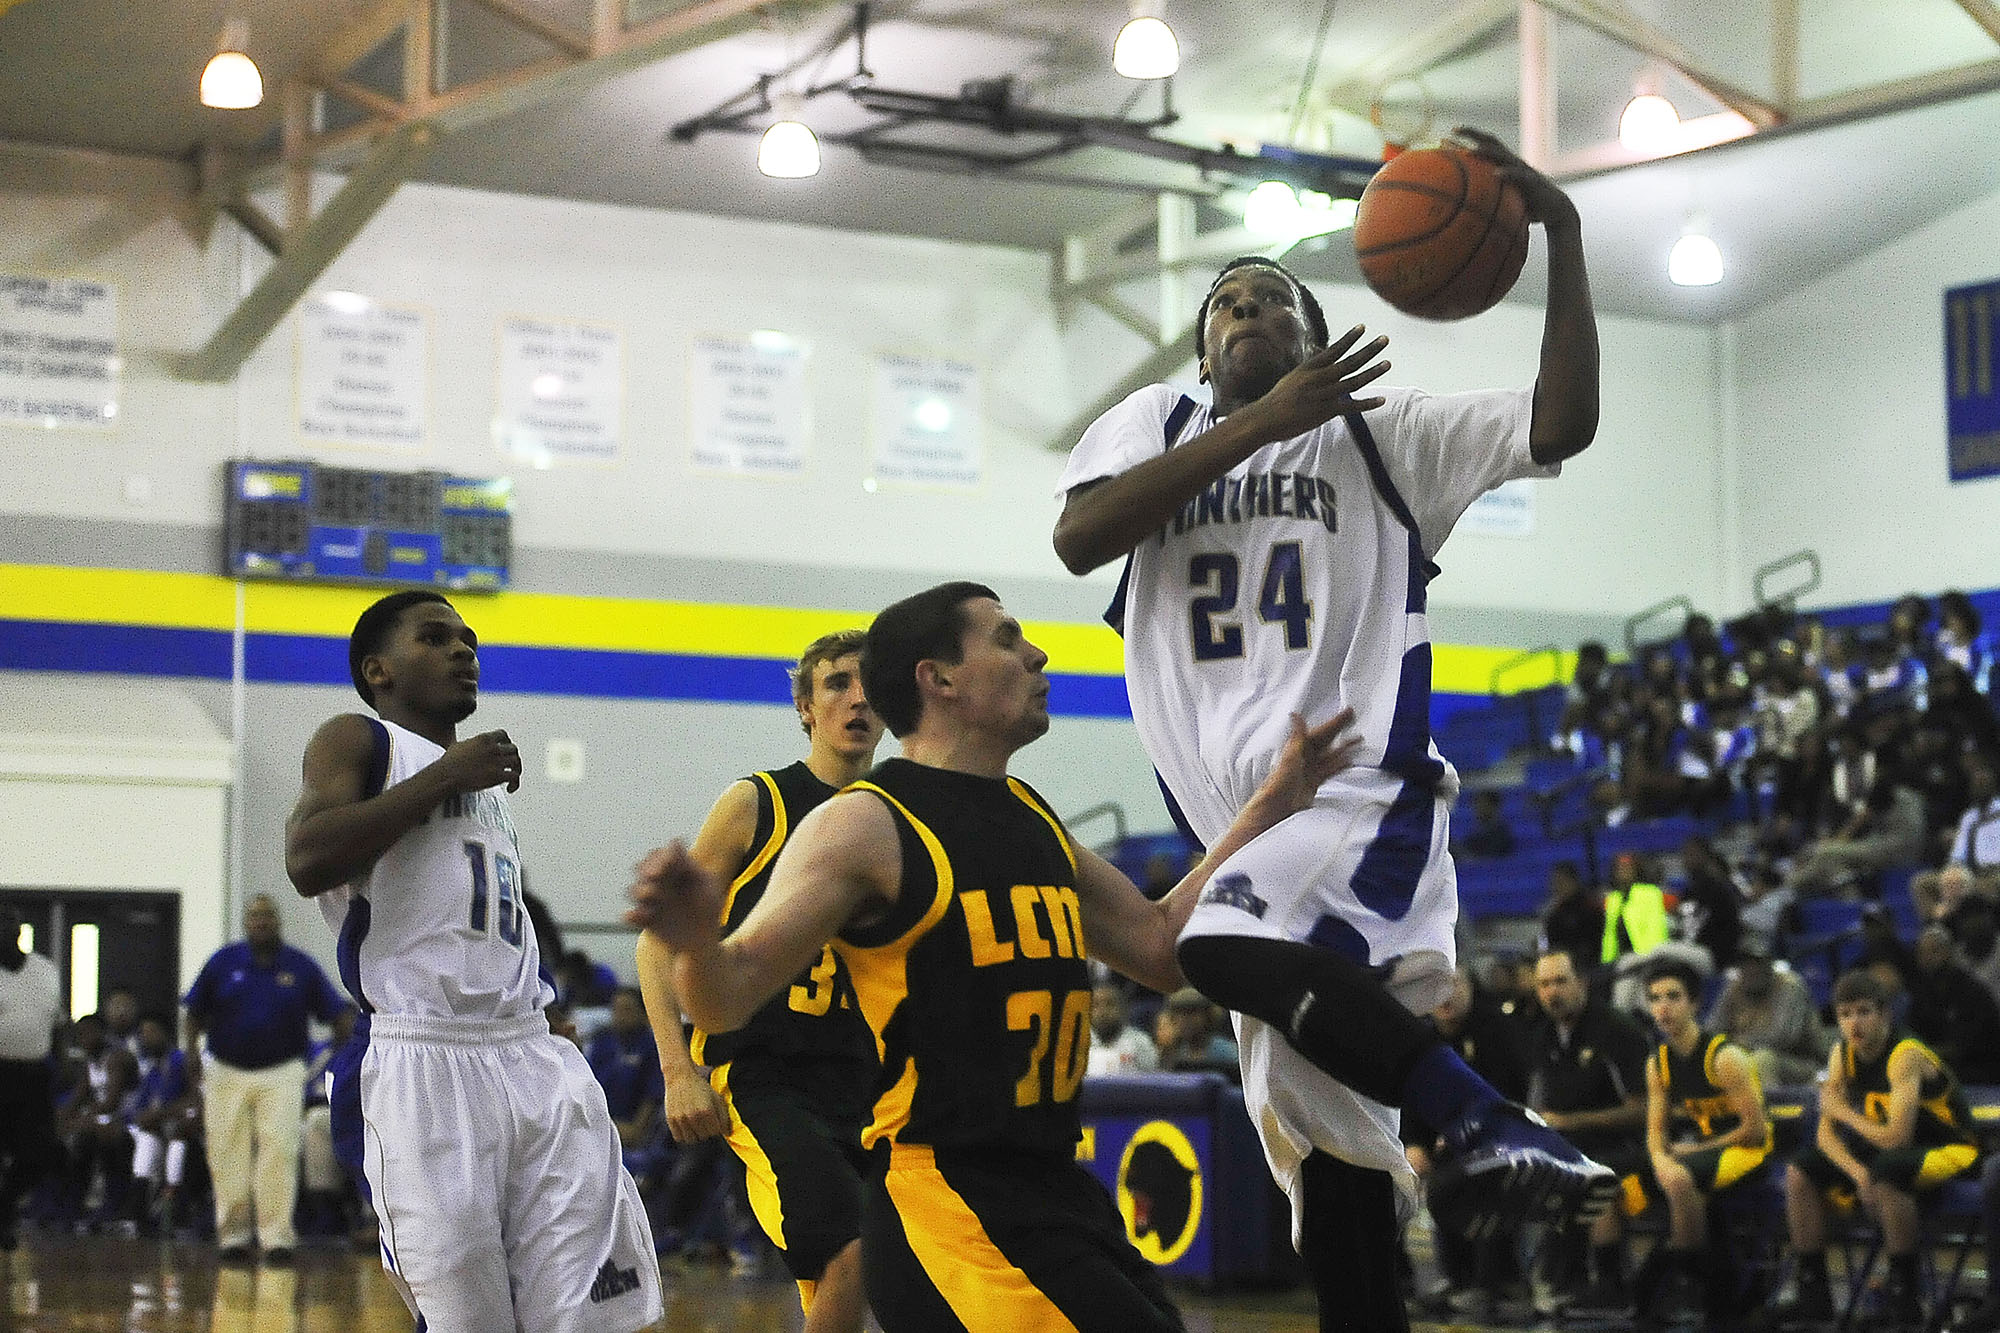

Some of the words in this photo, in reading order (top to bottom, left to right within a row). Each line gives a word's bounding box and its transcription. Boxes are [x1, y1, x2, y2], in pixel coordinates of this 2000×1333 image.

[1160, 470, 1338, 546] ANTHERS
[1189, 539, 1315, 663] 24
[788, 943, 850, 1017] 3
